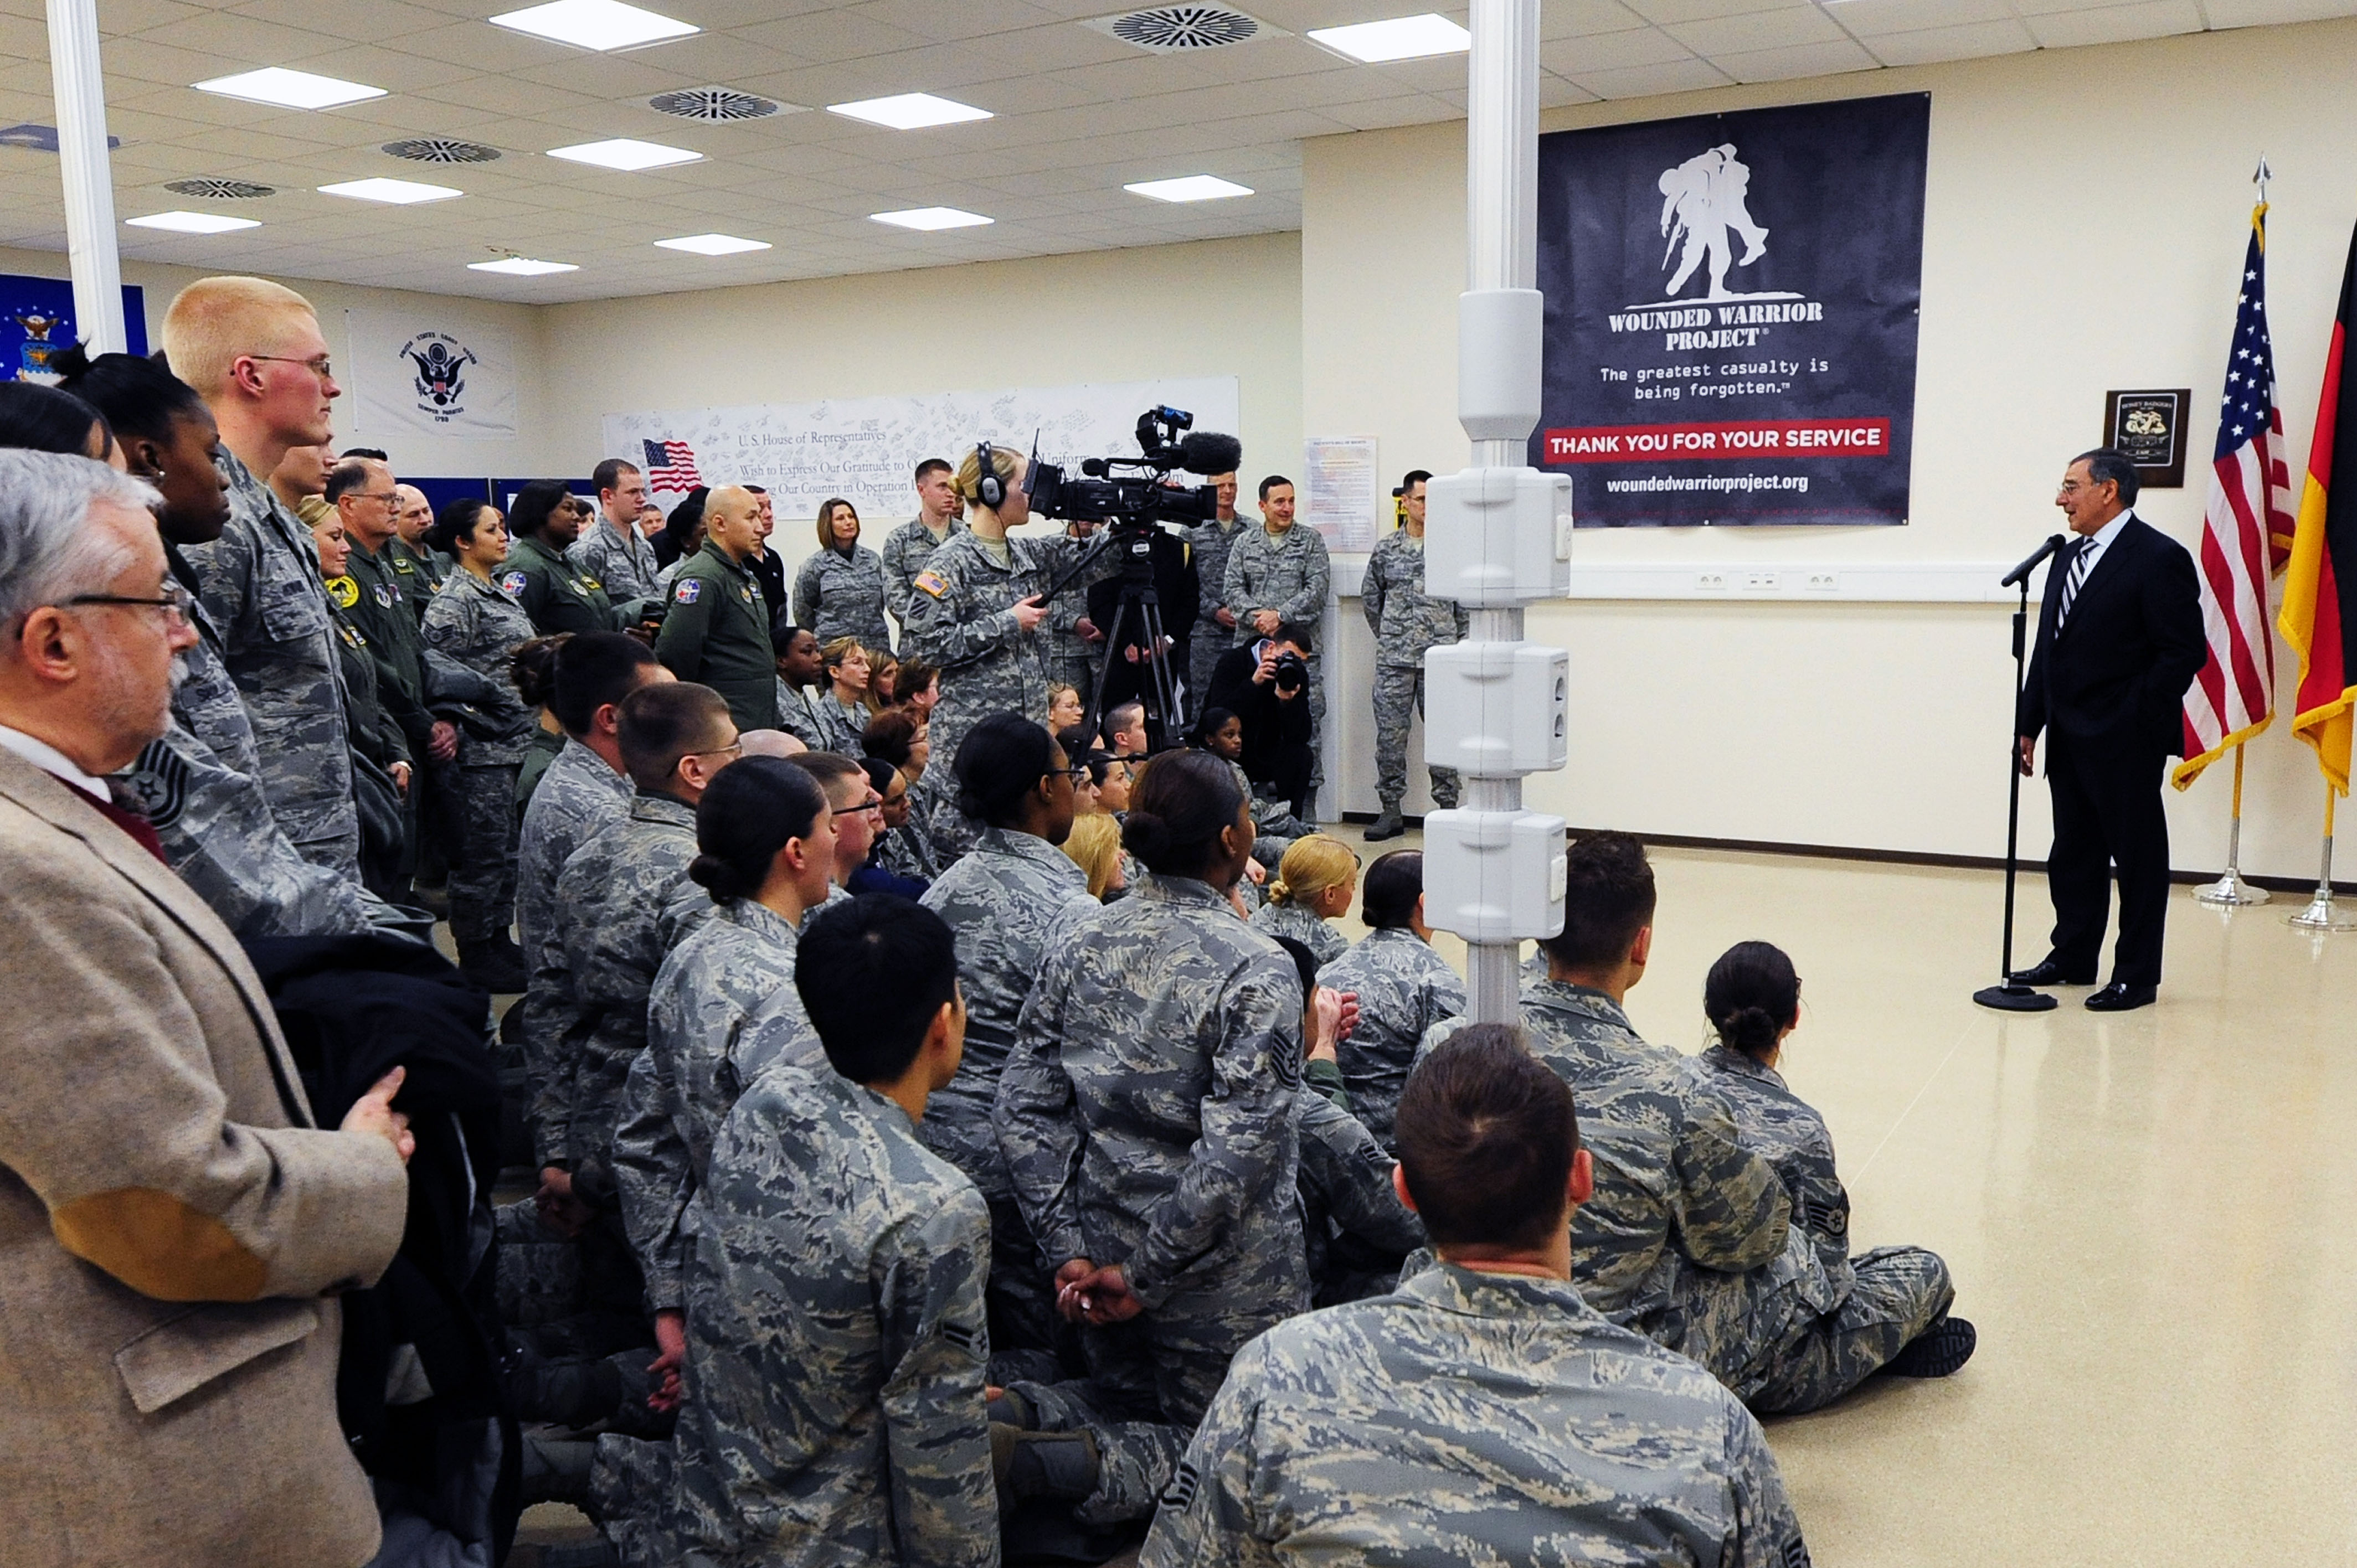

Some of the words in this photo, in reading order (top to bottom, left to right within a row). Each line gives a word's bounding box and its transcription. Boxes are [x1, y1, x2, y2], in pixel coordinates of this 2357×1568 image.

[1609, 308, 1712, 332] WOUNDED
[1718, 302, 1823, 325] WARRIOR
[1600, 368, 1628, 381] The
[1636, 364, 1711, 383] greatest
[1720, 359, 1799, 376] casualty
[1809, 358, 1829, 373] is
[1635, 385, 1680, 400] being
[763, 433, 793, 446] House
[796, 431, 807, 444] of
[811, 431, 886, 447] Representatives
[1551, 436, 1619, 454] THANK
[1625, 434, 1668, 451] YOU
[1673, 432, 1716, 450] FOR
[1721, 430, 1780, 448] YOUR
[1785, 427, 1881, 447] SERVICE
[739, 464, 764, 476] Wish
[766, 467, 776, 476] to
[779, 463, 817, 478] Express
[820, 461, 840, 474] Our
[843, 460, 891, 473] Gratitude
[894, 462, 904, 471] to
[778, 482, 798, 494] Our
[801, 482, 841, 497] Country
[843, 480, 853, 492] in
[856, 479, 908, 497] Operation
[1607, 473, 1809, 494] woundedwarriorproject.org
